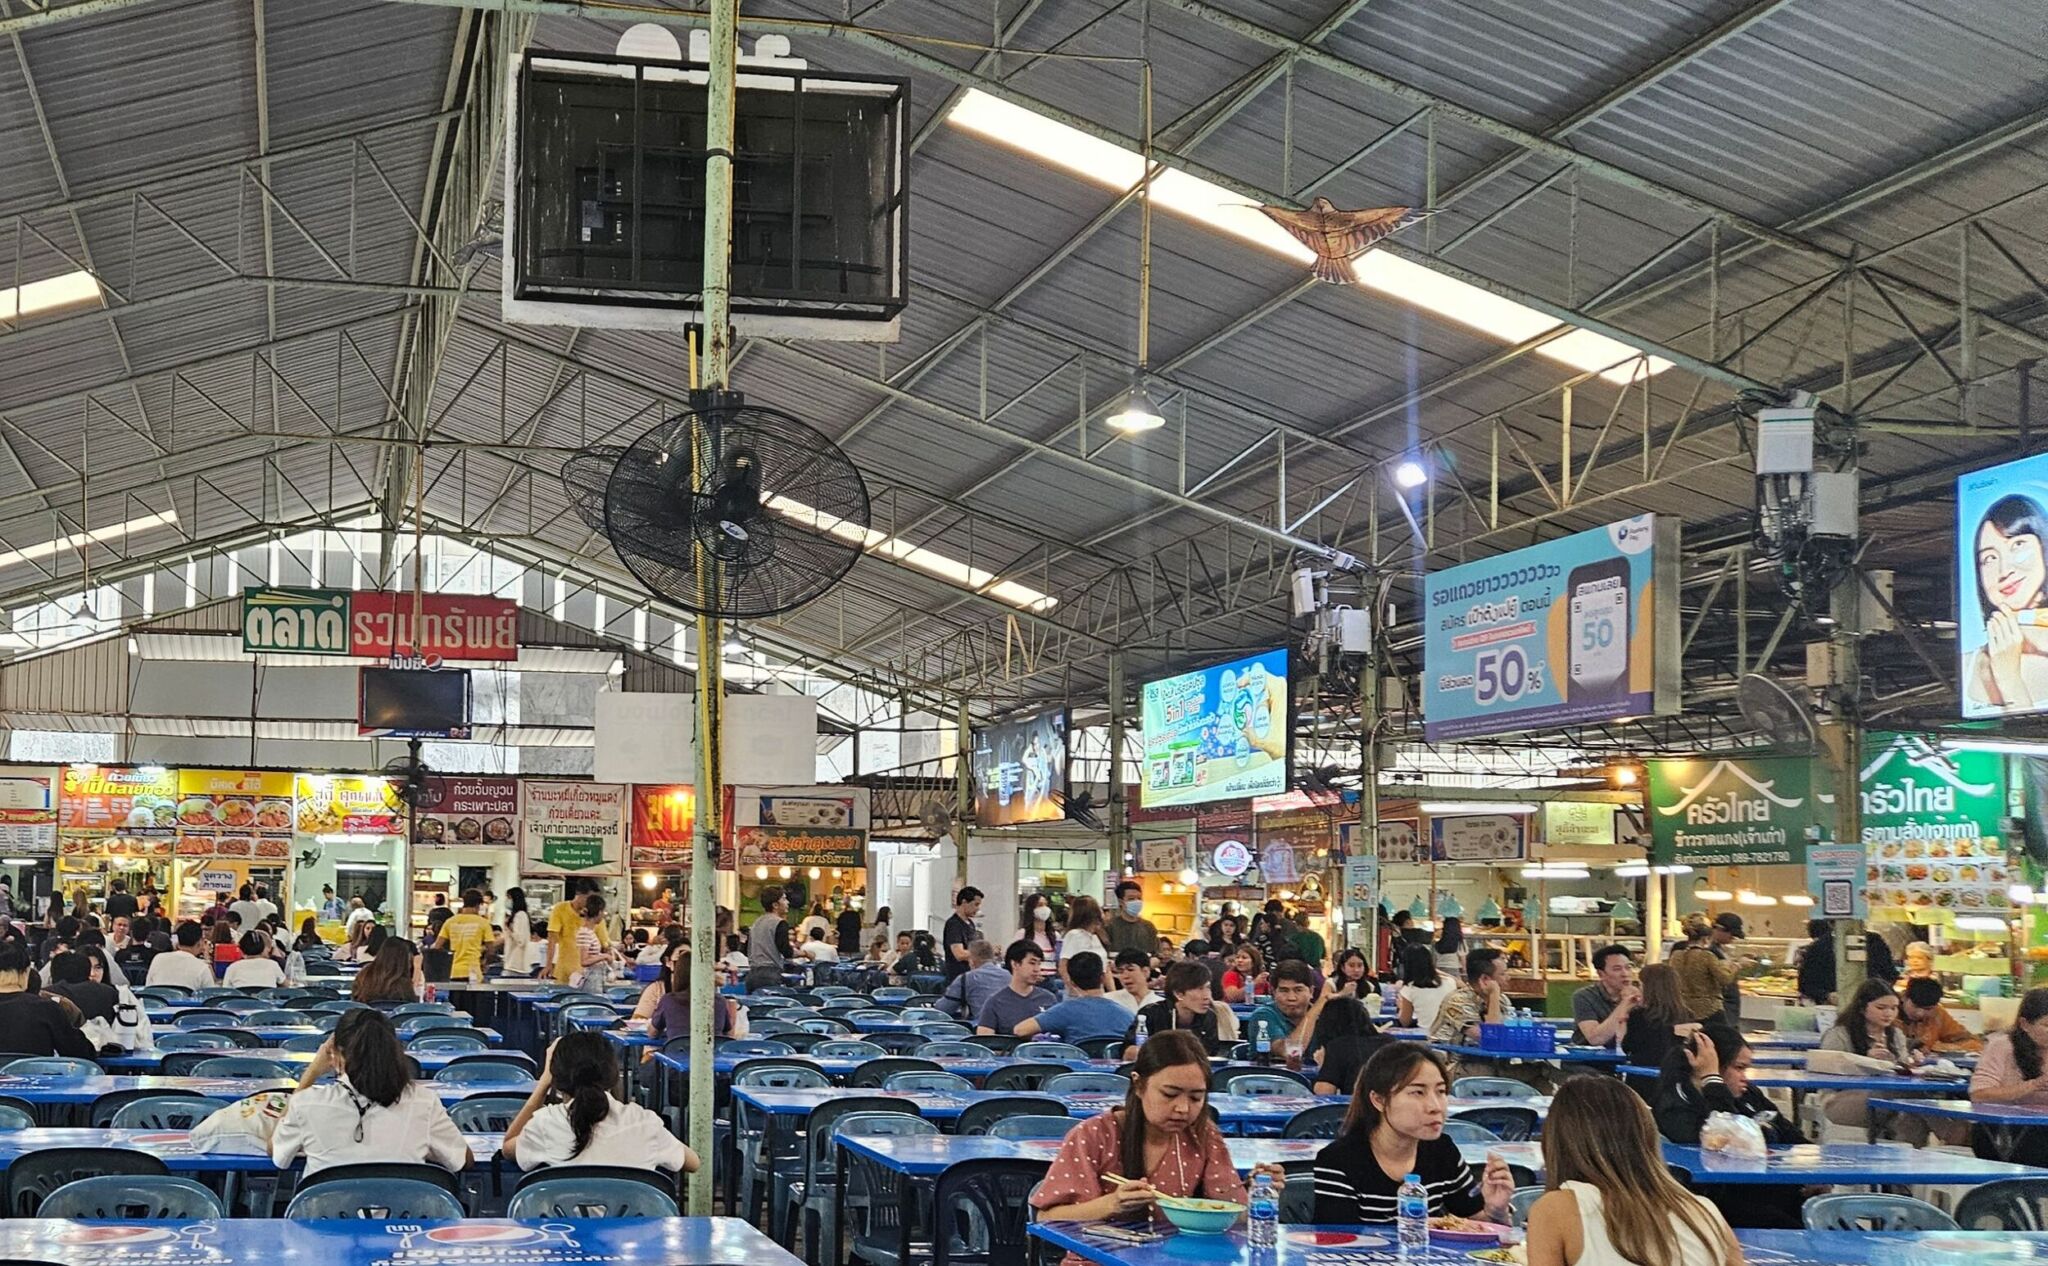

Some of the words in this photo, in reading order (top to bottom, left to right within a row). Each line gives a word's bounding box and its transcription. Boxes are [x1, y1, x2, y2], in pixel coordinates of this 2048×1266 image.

[246, 606, 344, 649] ตลาด
[353, 606, 517, 649] รวมทรัพย์
[1582, 619, 1614, 651] 50
[453, 800, 514, 813] กระเพาะปลา
[1687, 791, 1770, 825] ครัวไทย
